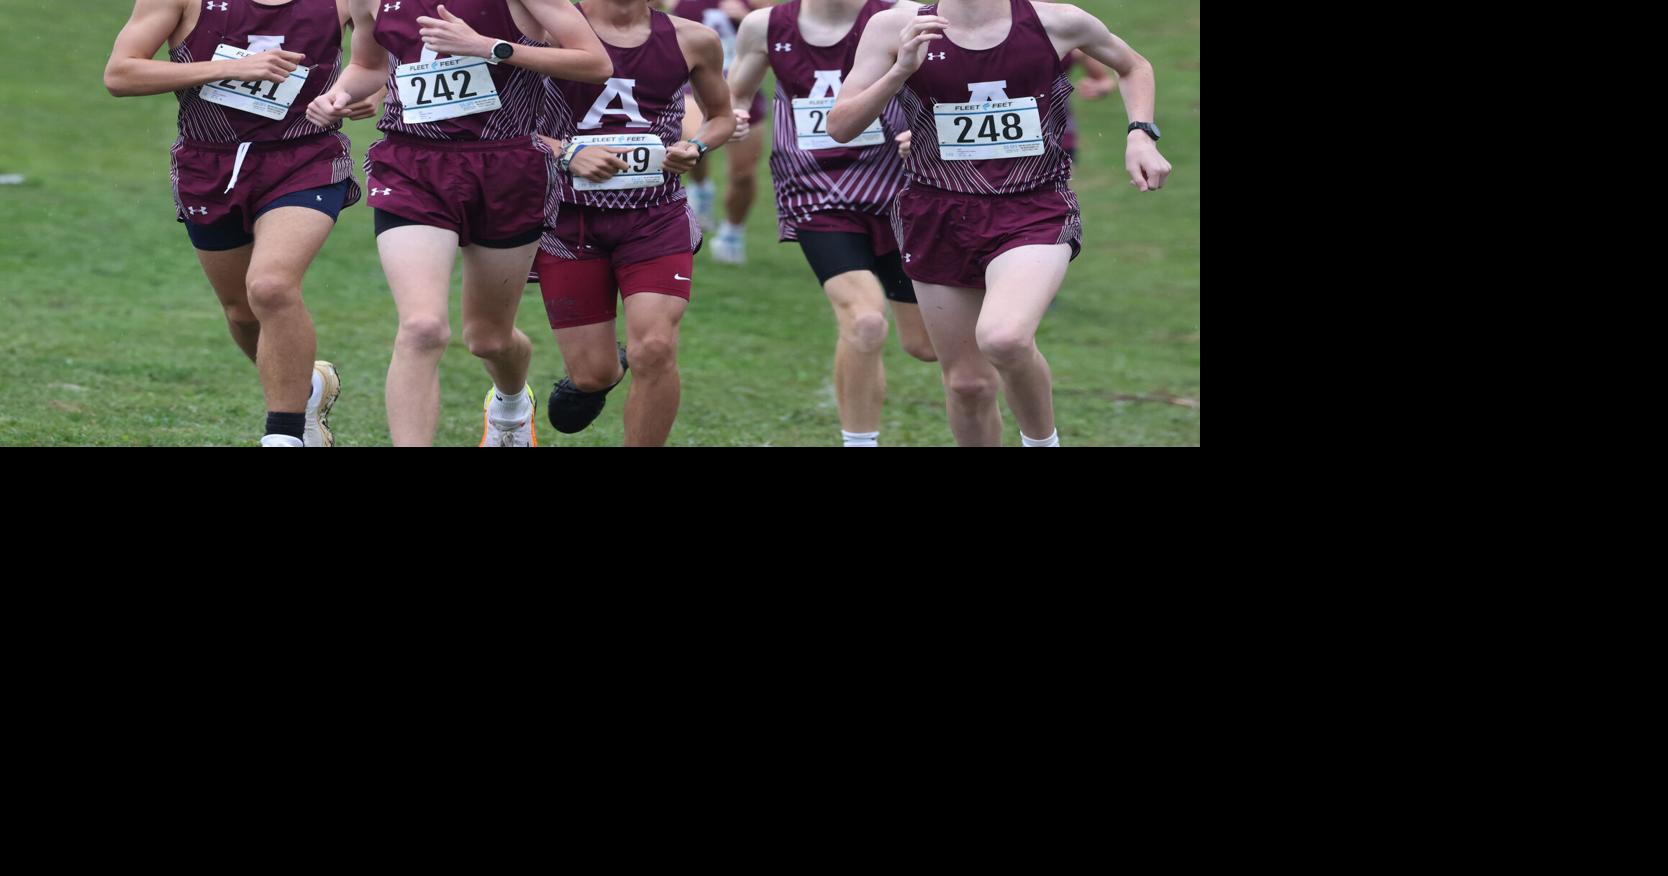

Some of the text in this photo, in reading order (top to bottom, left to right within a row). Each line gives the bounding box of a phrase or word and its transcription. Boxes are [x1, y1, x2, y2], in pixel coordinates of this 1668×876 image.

[440, 59, 460, 67] FEET
[411, 70, 477, 105] 242
[577, 77, 652, 129] A
[953, 112, 1023, 143] 248
